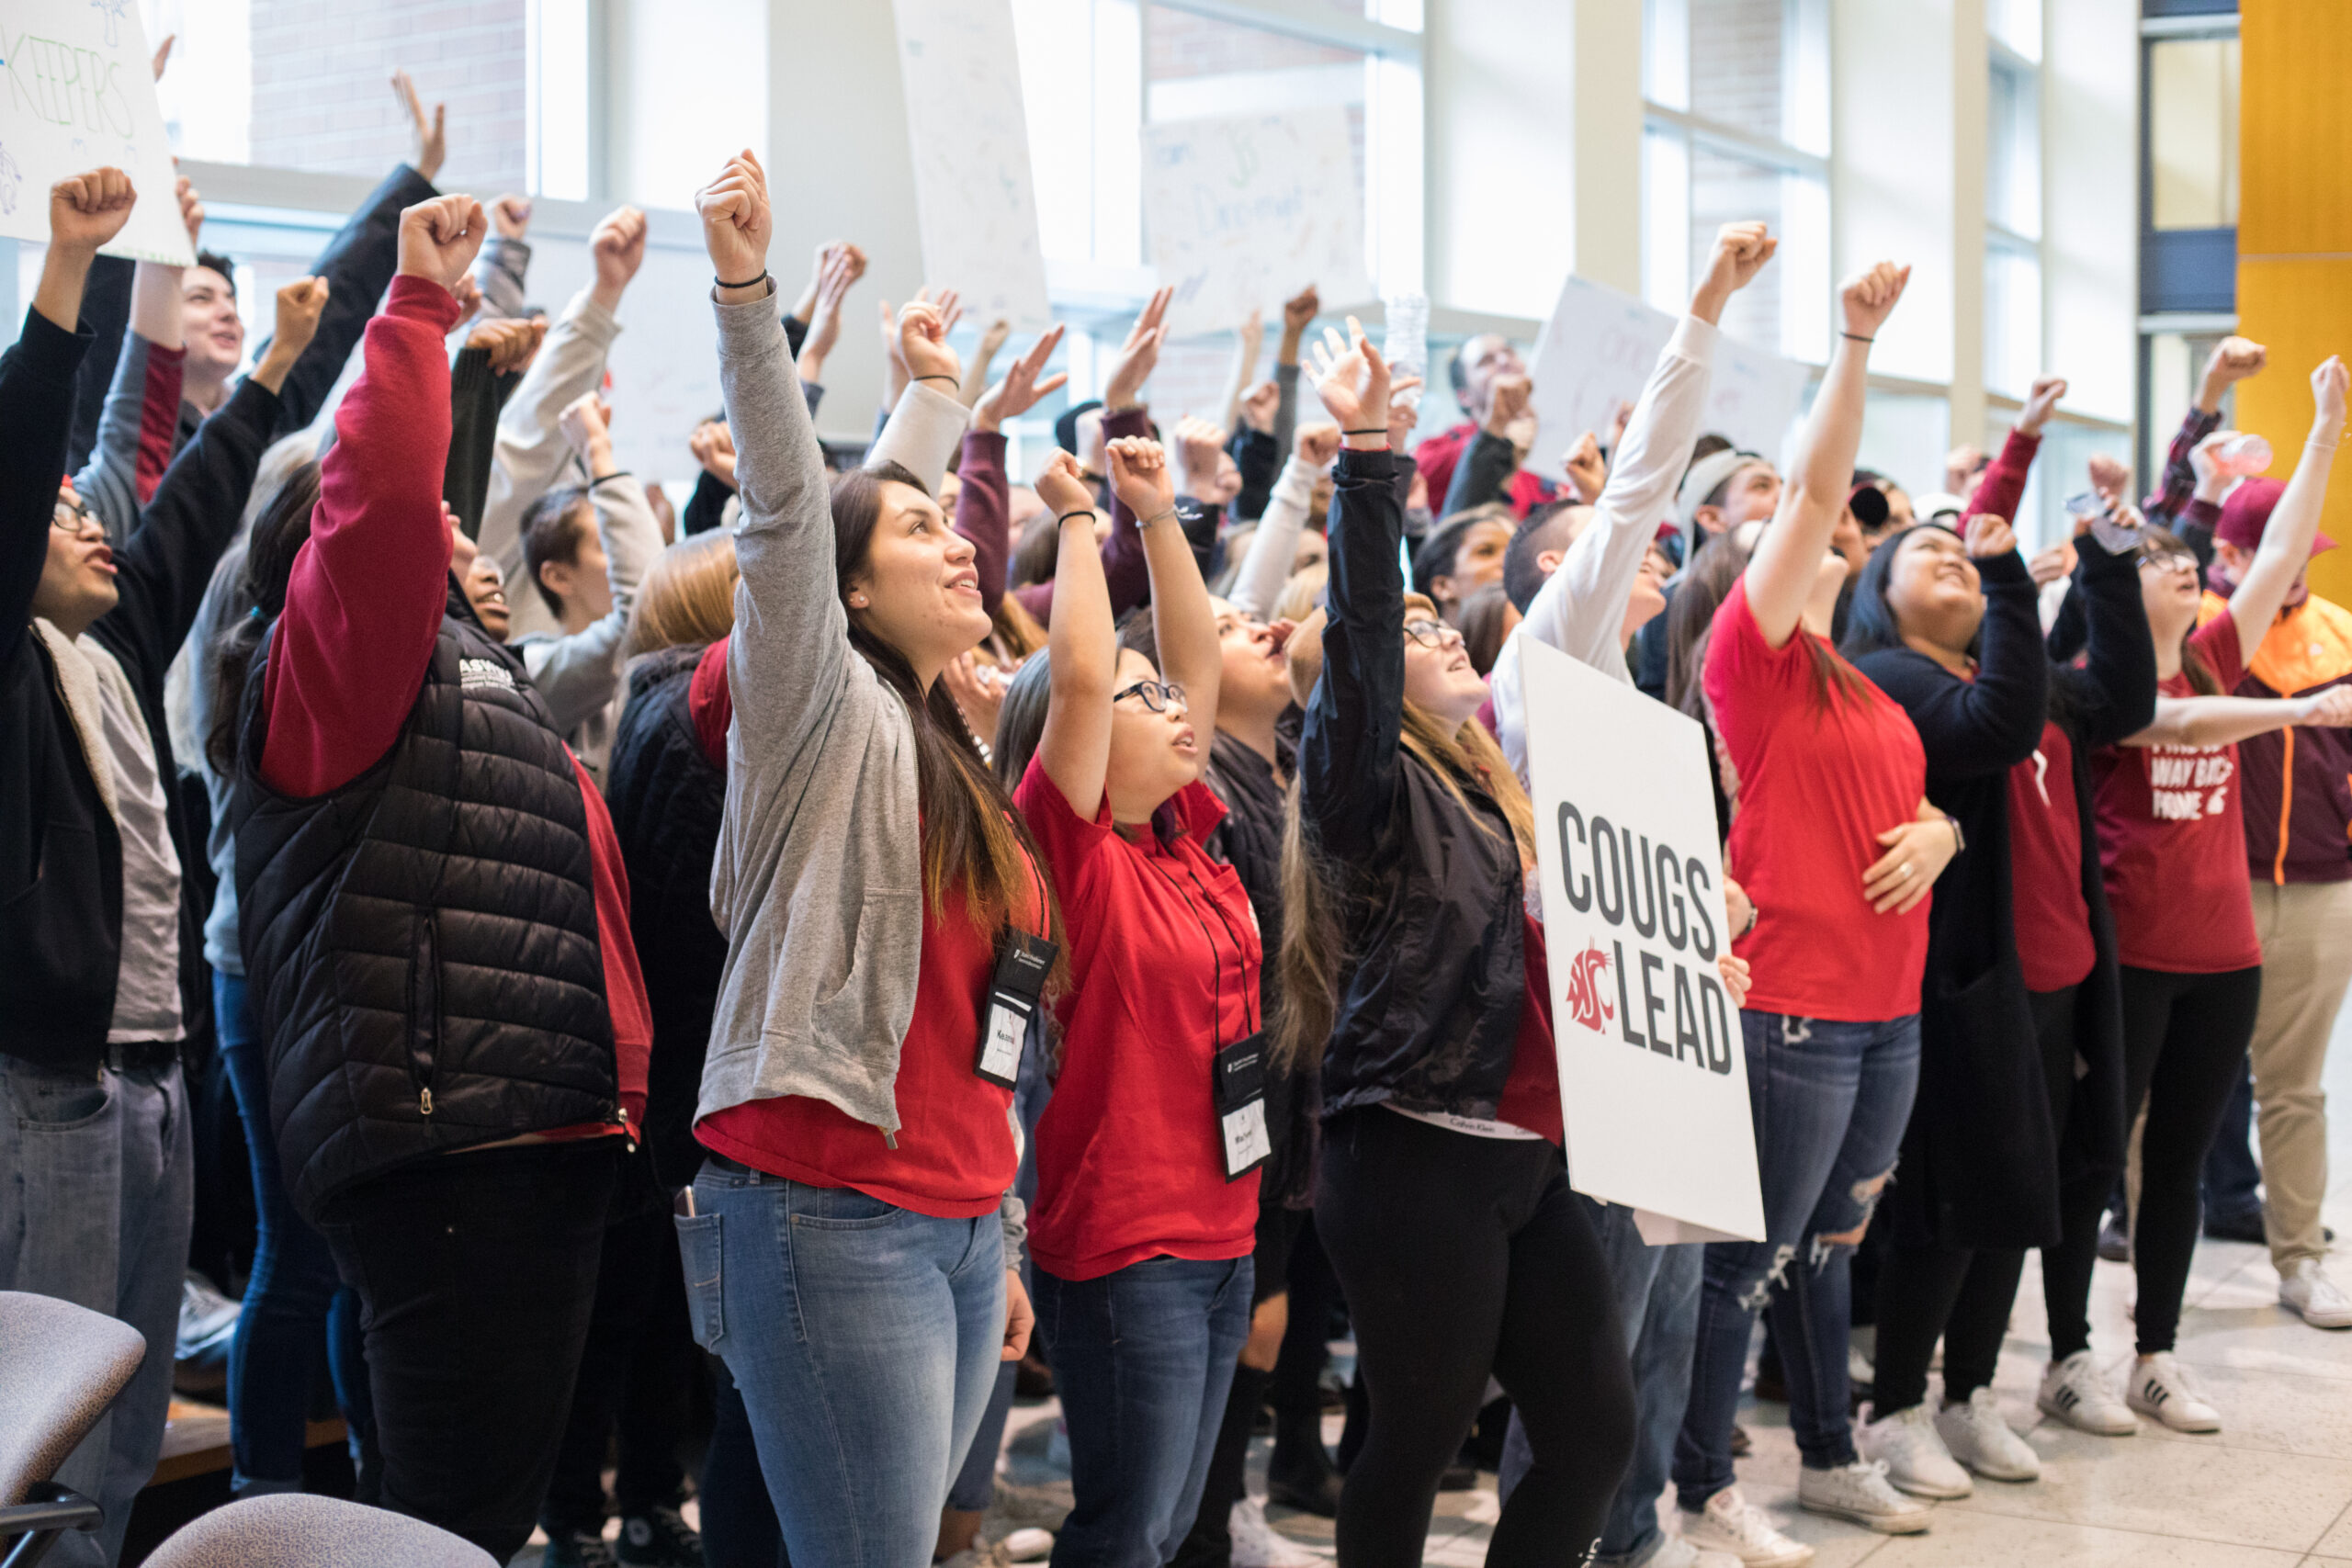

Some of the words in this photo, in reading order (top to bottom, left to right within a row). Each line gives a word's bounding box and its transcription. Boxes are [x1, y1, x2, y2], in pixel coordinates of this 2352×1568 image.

[1, 24, 134, 139] KEEPERS
[2151, 757, 2196, 787] WAY
[1557, 801, 1717, 963] COUGS
[1612, 939, 1732, 1076] LEAD
[1449, 1116, 1476, 1130] Calvin
[1476, 1123, 1495, 1134] Klein
